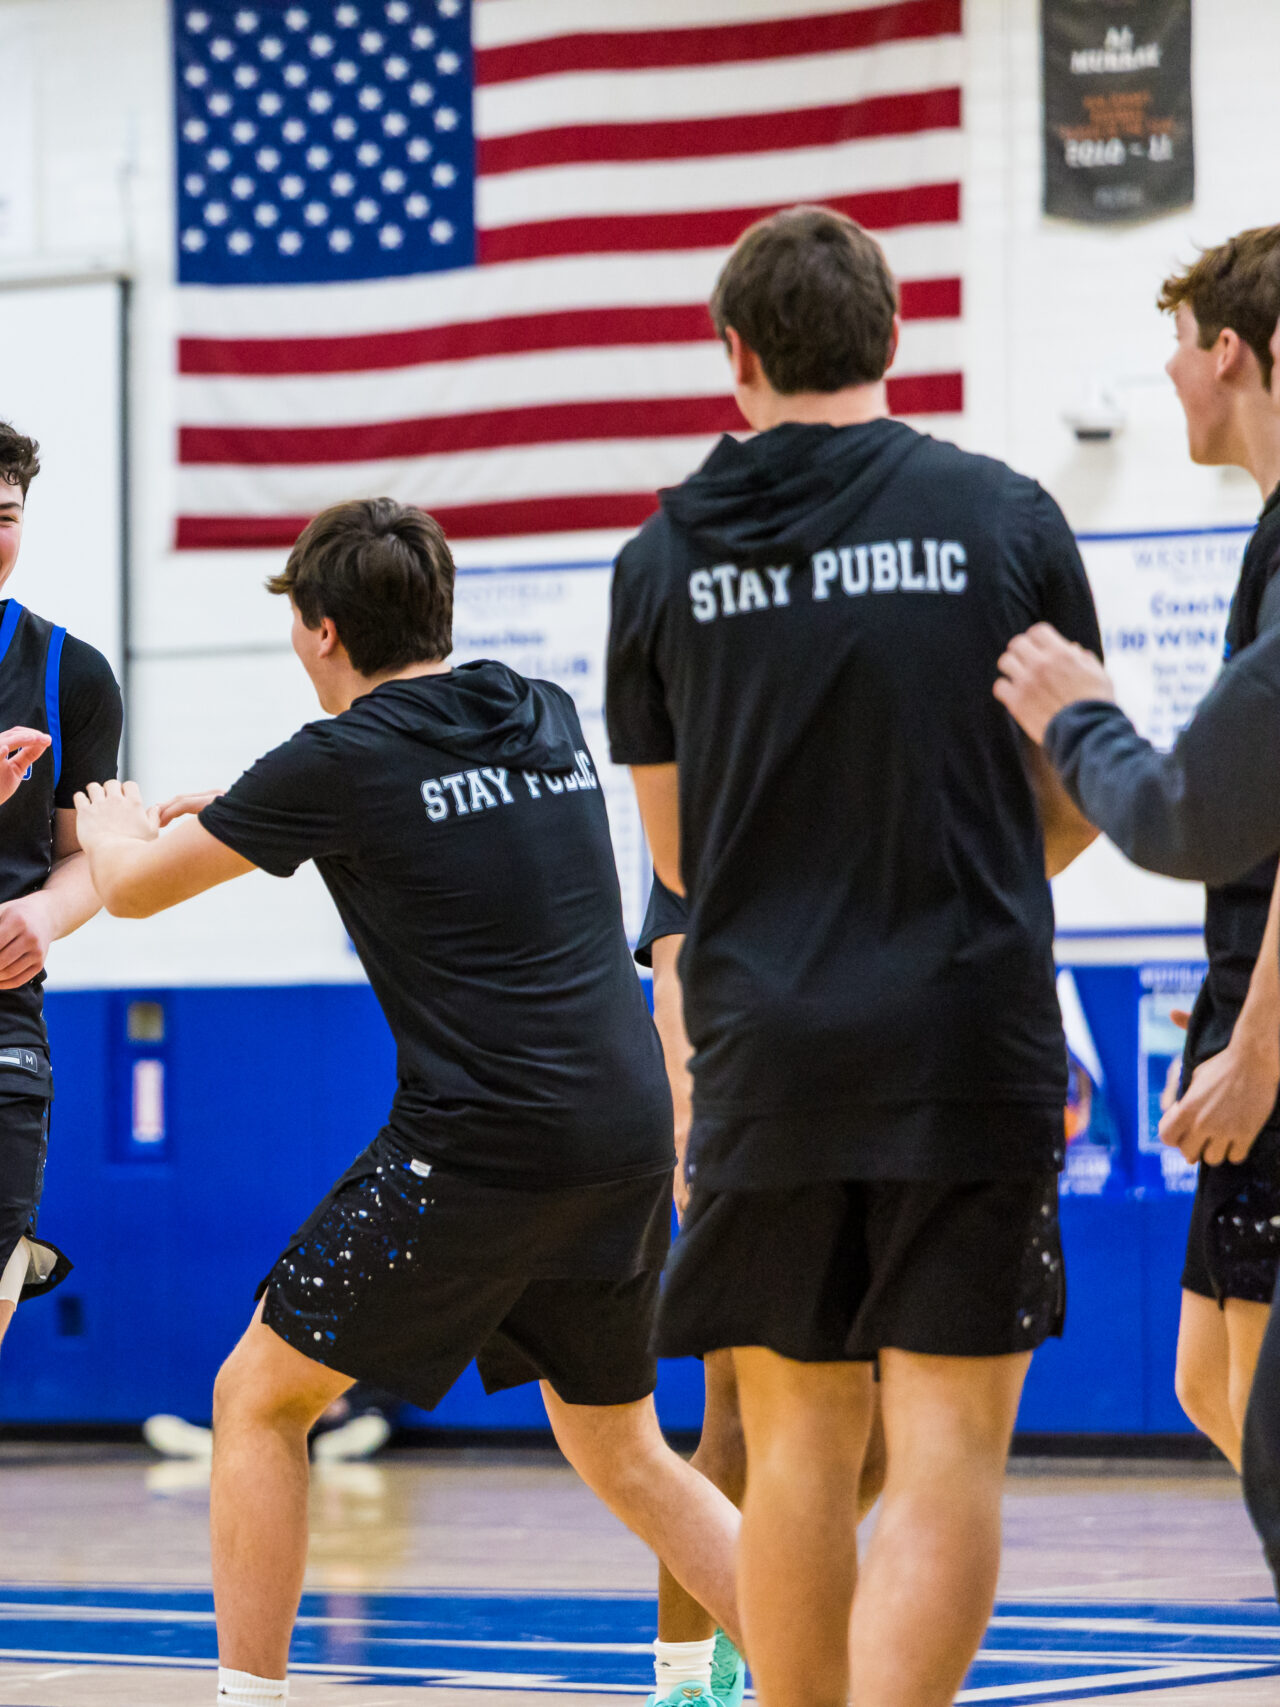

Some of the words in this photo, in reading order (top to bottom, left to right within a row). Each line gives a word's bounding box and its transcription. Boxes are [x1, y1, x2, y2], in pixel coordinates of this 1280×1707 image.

[688, 564, 792, 624] STAY
[812, 538, 967, 601] PUBLIC
[421, 767, 515, 823] STAY
[25, 1054, 34, 1065] M
